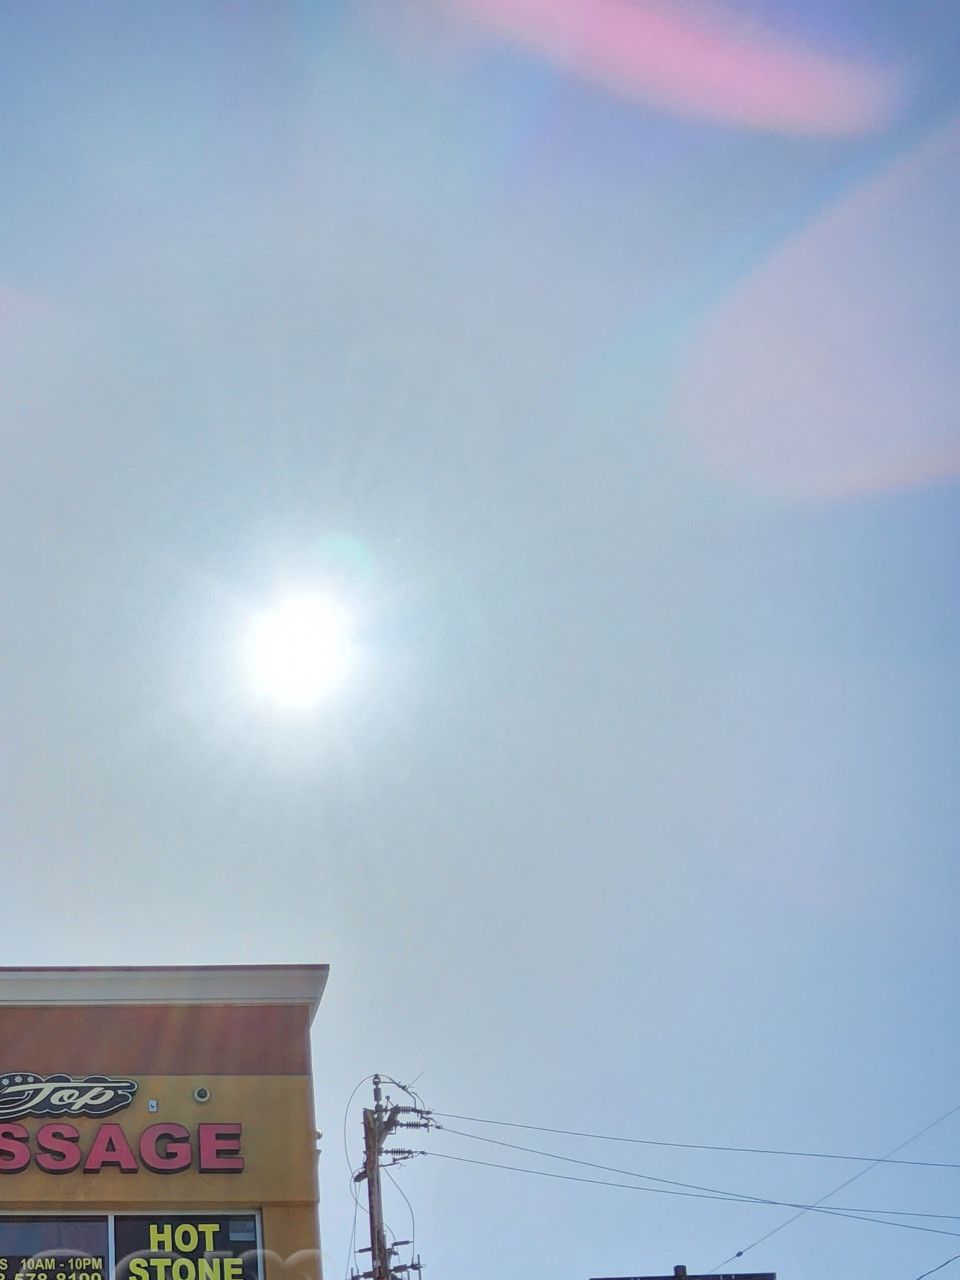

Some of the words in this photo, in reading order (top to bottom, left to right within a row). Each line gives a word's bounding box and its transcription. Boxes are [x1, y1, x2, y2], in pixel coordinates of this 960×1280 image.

[149, 1223, 220, 1252] HOT
[20, 1257, 56, 1270] 10AM
[67, 1257, 102, 1270] 10PM
